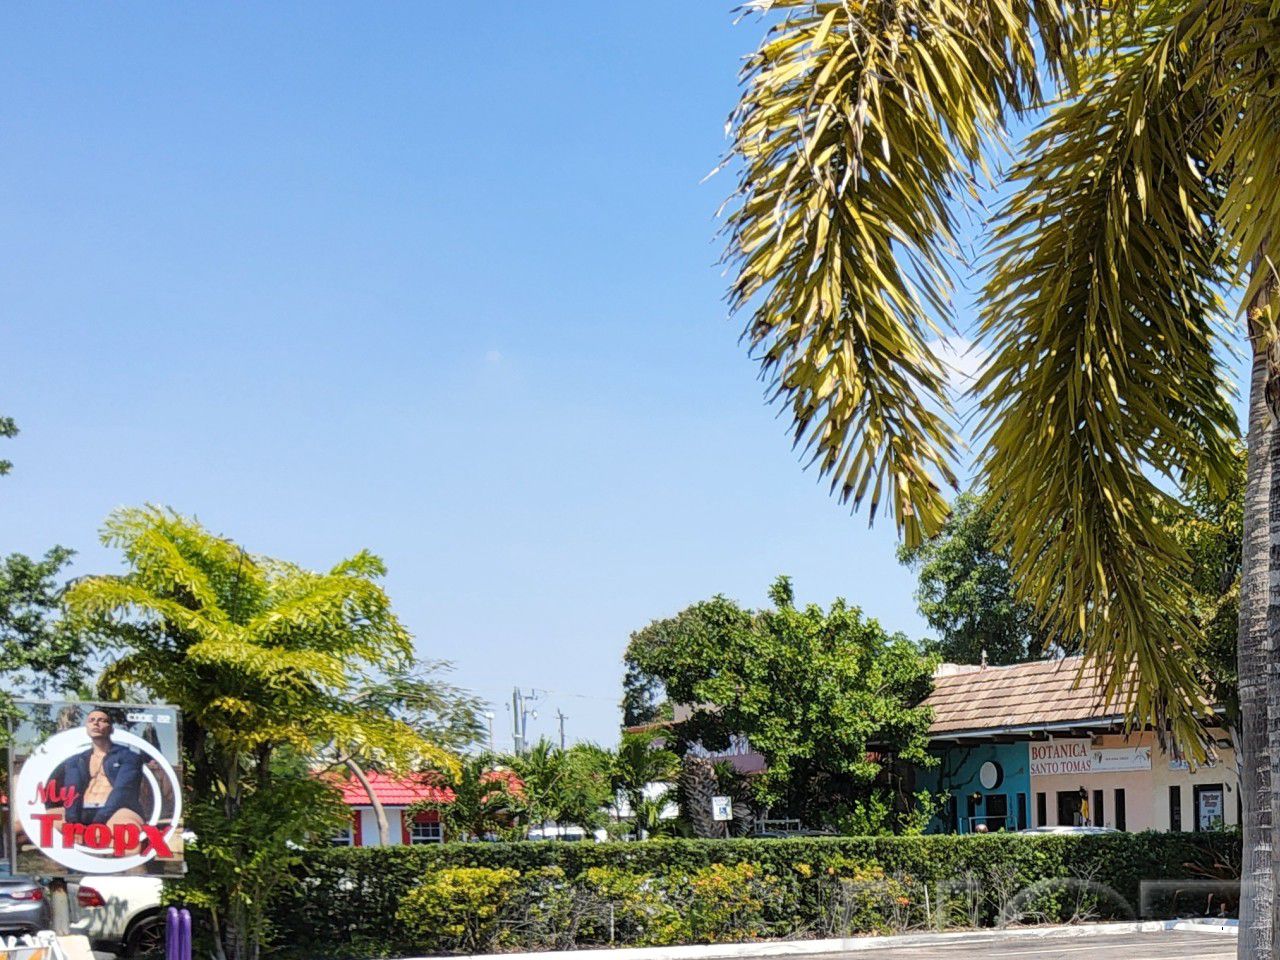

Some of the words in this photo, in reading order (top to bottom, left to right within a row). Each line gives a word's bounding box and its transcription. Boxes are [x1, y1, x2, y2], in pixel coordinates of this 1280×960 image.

[1031, 743, 1088, 760] BOTANICA
[1030, 762, 1059, 775] SANTO
[1060, 760, 1092, 773] TOMAS
[28, 778, 80, 809] My
